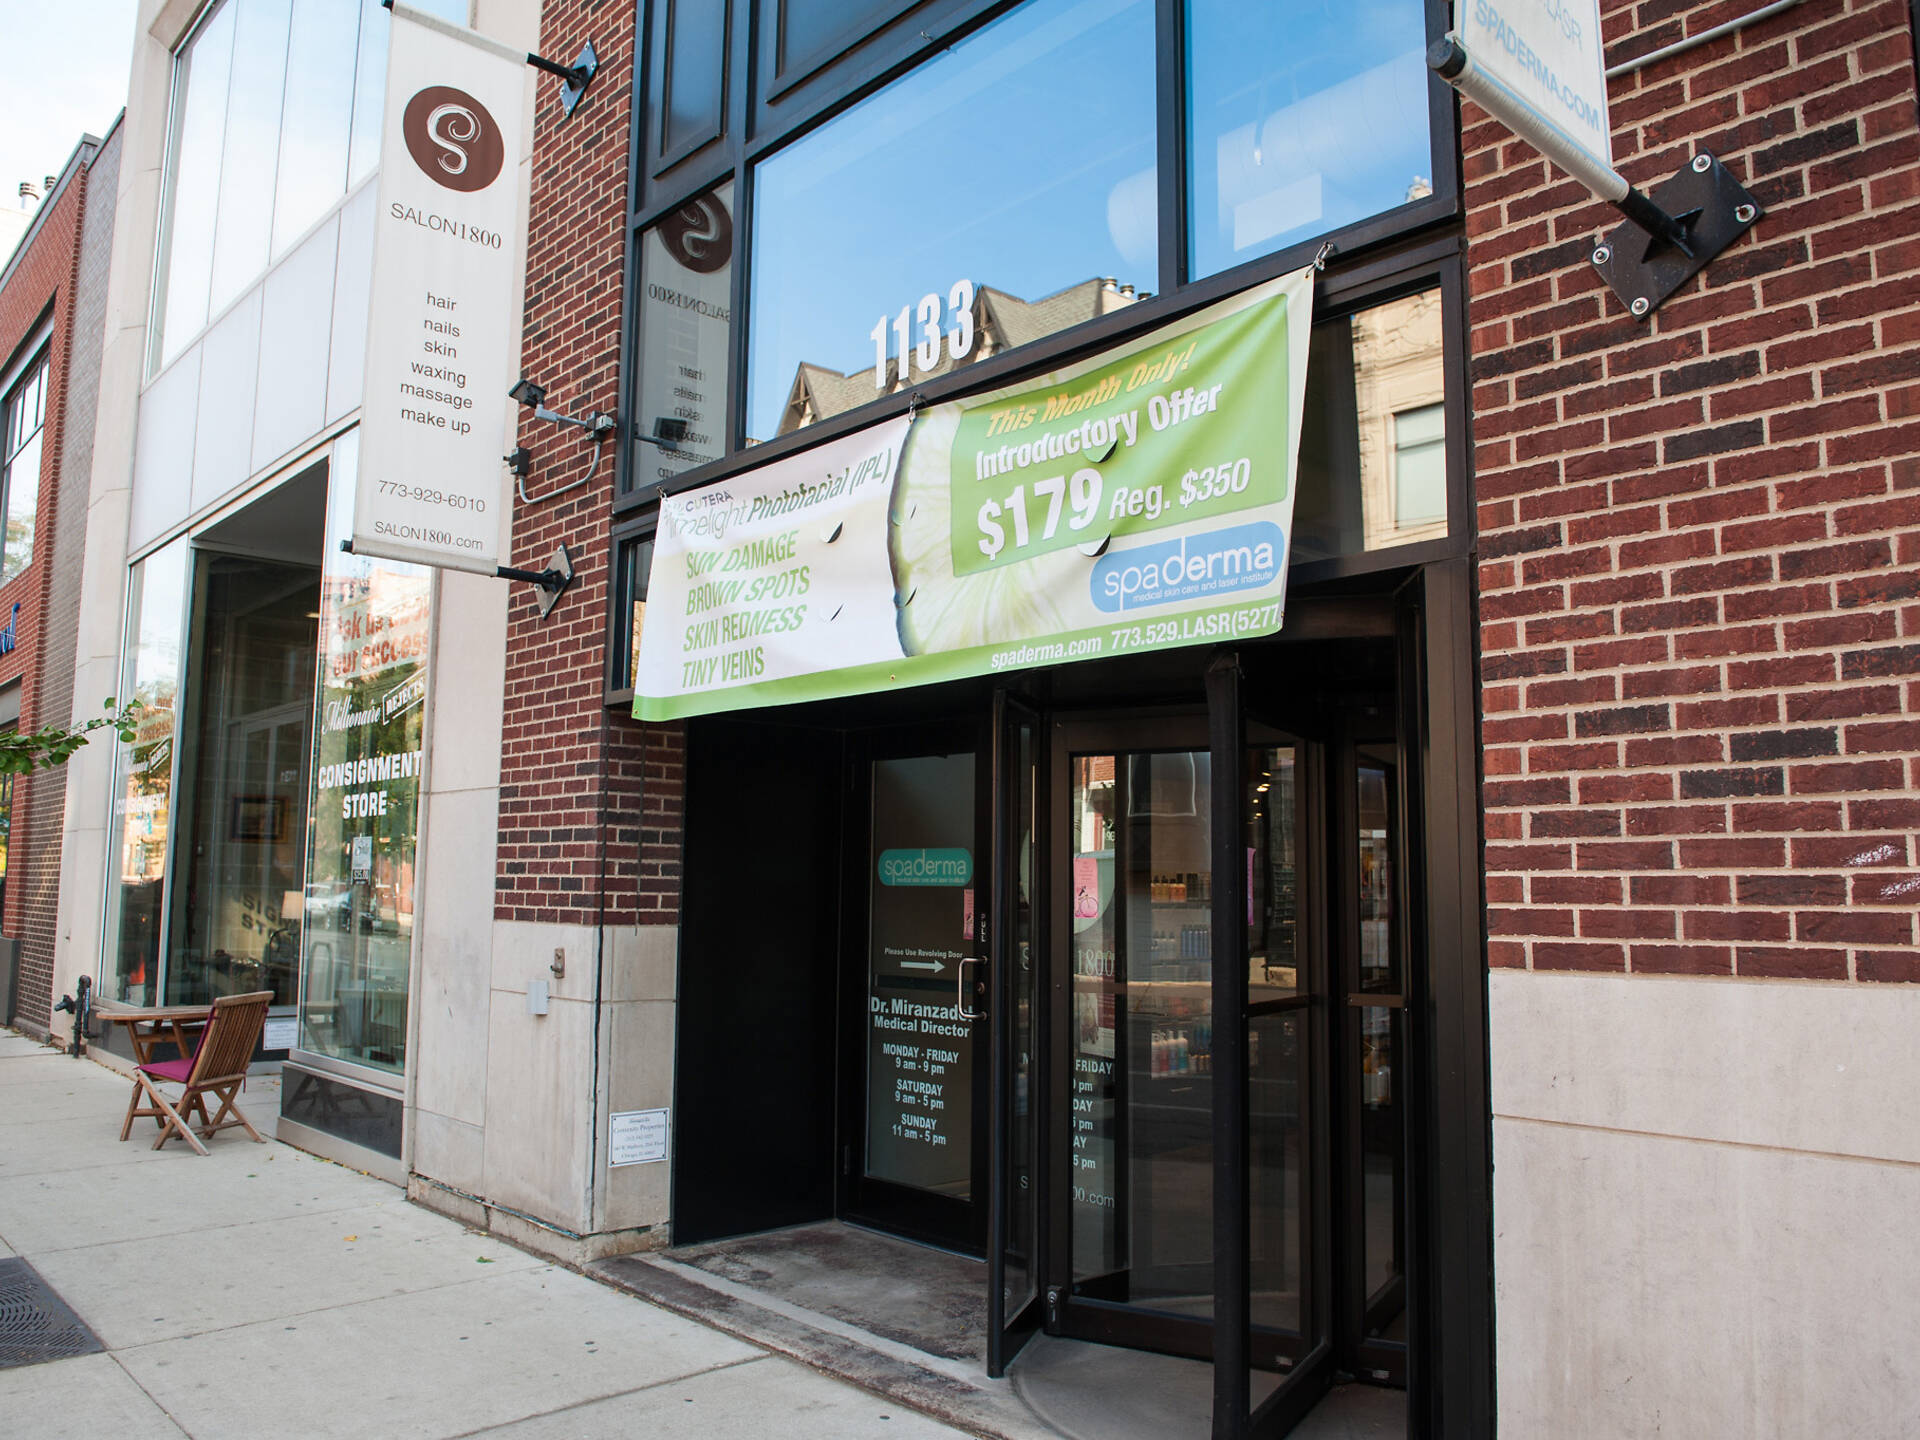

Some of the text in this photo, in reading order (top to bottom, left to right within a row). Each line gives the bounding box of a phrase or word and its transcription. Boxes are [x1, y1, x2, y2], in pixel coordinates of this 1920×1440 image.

[1475, 0, 1600, 131] SPADERMA.COM
[390, 202, 502, 249] SALON1800
[427, 292, 457, 311] hair
[424, 317, 461, 338] nails
[870, 278, 974, 390] 1133
[424, 340, 457, 359] skin
[411, 361, 467, 388] waxing
[400, 382, 473, 410] massage
[986, 342, 1198, 438] This Month Only!
[401, 407, 472, 435] make up
[976, 383, 1222, 481] Introductory Offer
[378, 480, 486, 513] 773-929-6010
[747, 467, 850, 523] Photofacial
[849, 448, 892, 495] (IPL)
[685, 490, 734, 512] CUTERA
[977, 457, 1251, 561] $179 Reg. $350
[374, 520, 484, 550] SALON1800.com
[686, 529, 800, 579] SUN DAMAGE
[1104, 536, 1274, 611] spaderma
[686, 565, 810, 616] BROWN SPOTS
[683, 604, 807, 652] SKIN REDNESS
[682, 646, 764, 688] TINY VEINS
[991, 635, 1102, 670] spaderma.com
[322, 694, 381, 735] Millionaire
[318, 750, 422, 789] CONSIGNMENT
[343, 791, 387, 819] STORE
[884, 848, 967, 886] spaderma
[905, 948, 918, 956] Use
[948, 950, 963, 958] Door
[871, 996, 889, 1013] Dr.
[874, 1015, 970, 1038] Medical Director
[883, 1042, 919, 1059] MONDAY
[926, 1048, 959, 1064] FRIDAY
[895, 1057, 901, 1068] 9
[903, 1061, 916, 1070] am
[923, 1060, 929, 1071] 9
[931, 1064, 945, 1076] pm
[1075, 1059, 1112, 1074] FRIDAY
[895, 1090, 901, 1102] 9
[902, 1094, 916, 1104] am
[923, 1095, 929, 1106] 5
[930, 1099, 944, 1110] pm
[896, 1078, 943, 1097] SATURDAY
[892, 1124, 902, 1136] 11
[904, 1128, 918, 1139] am
[925, 1131, 931, 1142] 5
[932, 1134, 947, 1145] pm
[901, 1113, 937, 1130] SUNDAY
